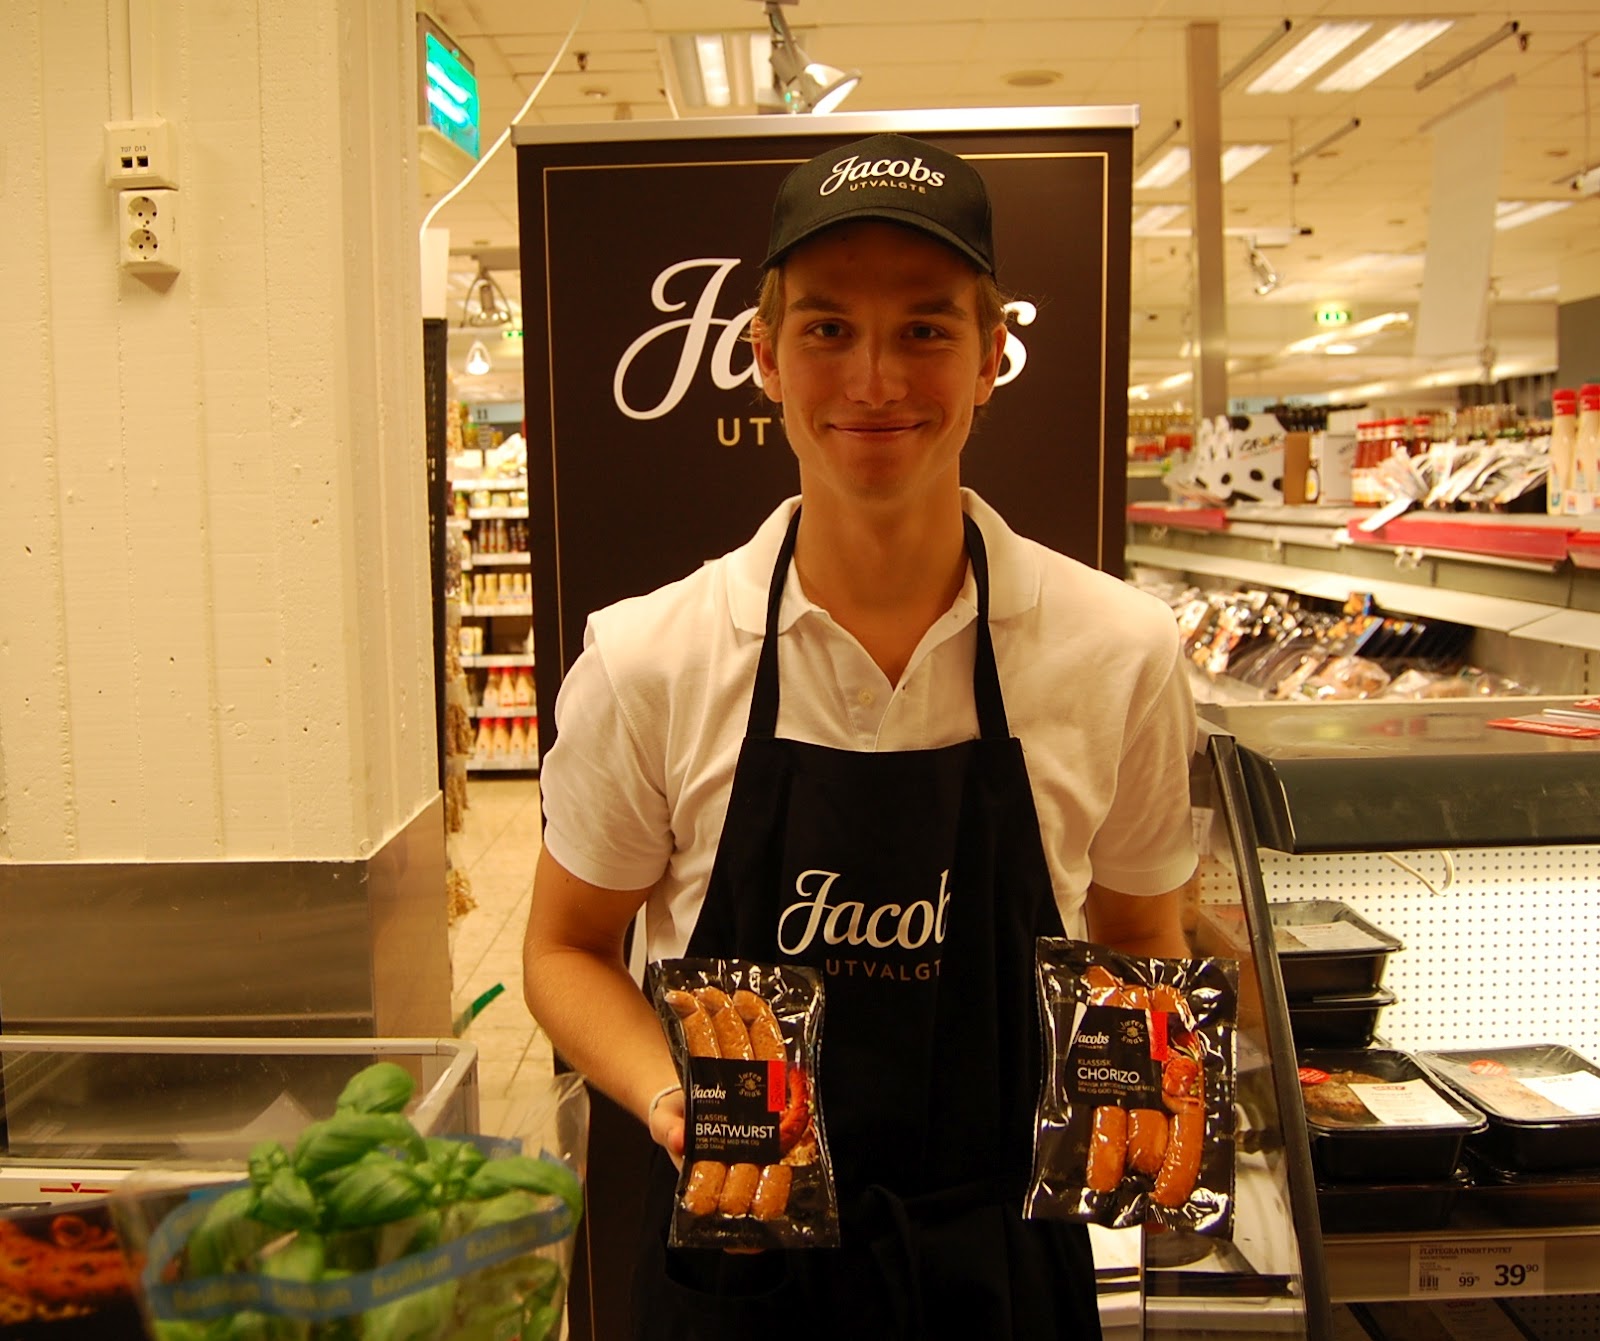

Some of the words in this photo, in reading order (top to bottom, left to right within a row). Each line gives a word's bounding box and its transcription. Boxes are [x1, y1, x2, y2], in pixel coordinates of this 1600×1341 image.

[819, 155, 946, 196] Jacobs
[849, 180, 927, 195] UTVALGTE
[1077, 1067, 1140, 1084] CHORIZO
[691, 1083, 726, 1099] Jacobs
[695, 1122, 775, 1139] BRATWURST
